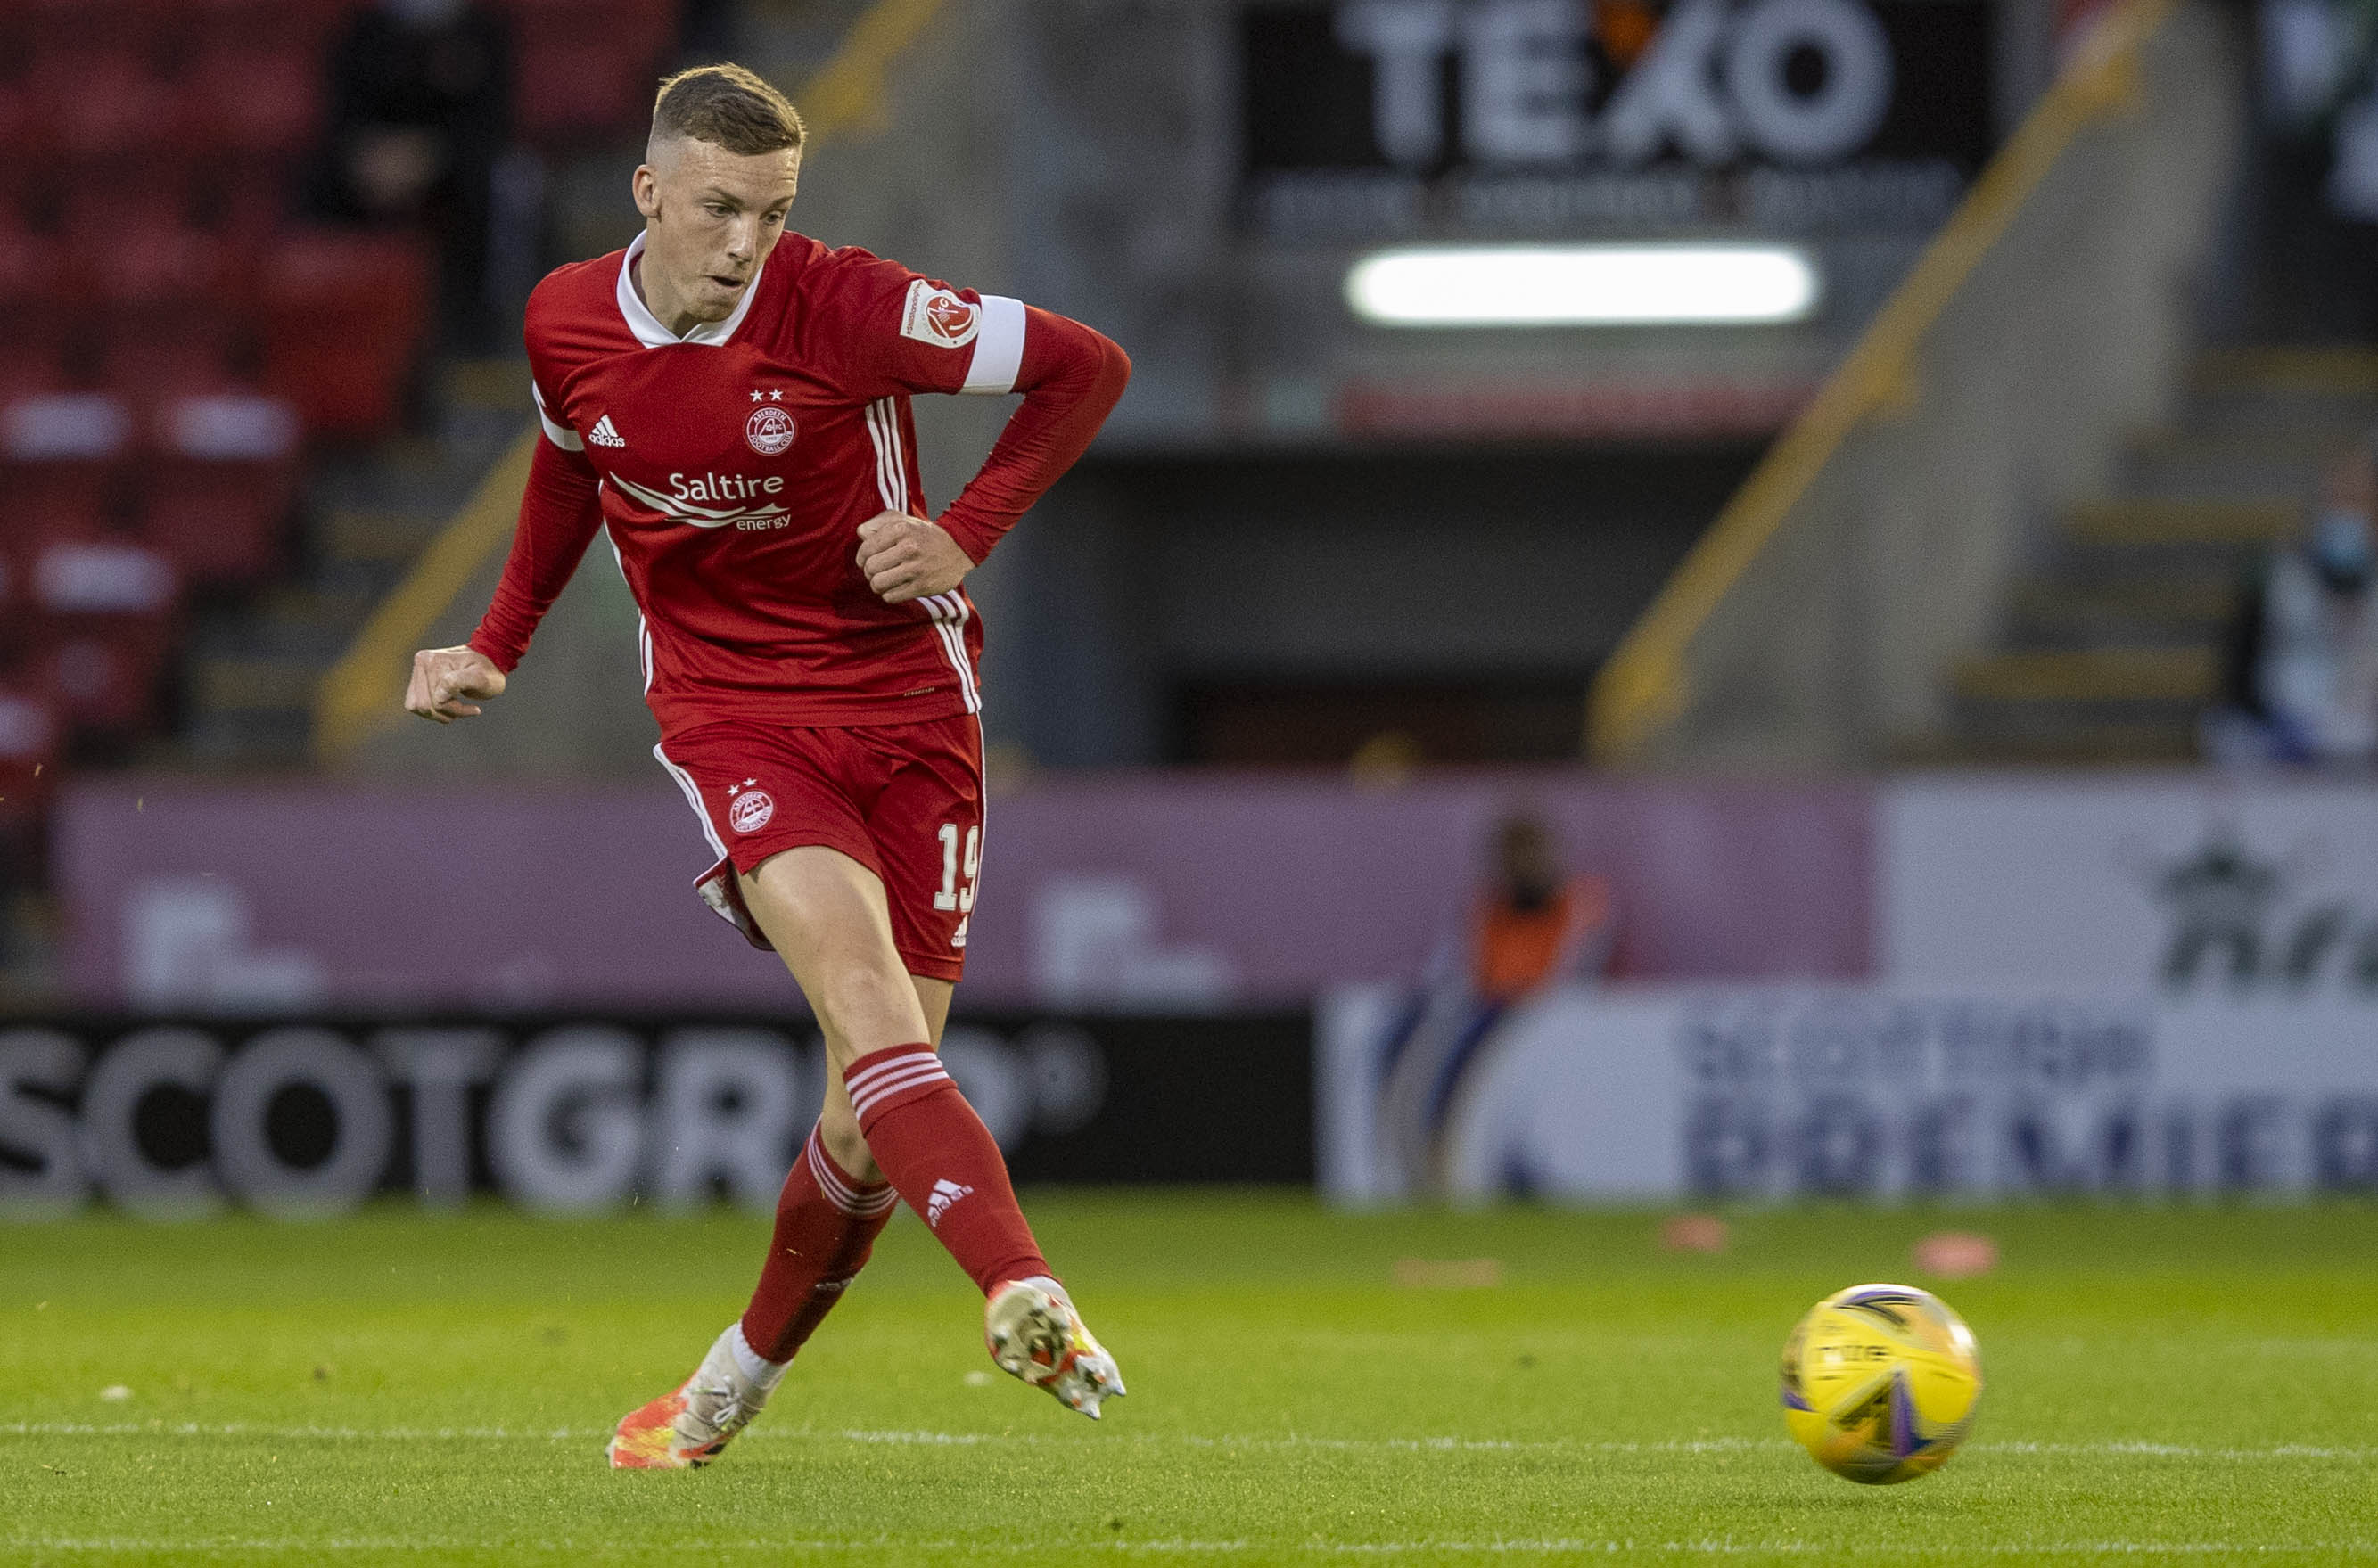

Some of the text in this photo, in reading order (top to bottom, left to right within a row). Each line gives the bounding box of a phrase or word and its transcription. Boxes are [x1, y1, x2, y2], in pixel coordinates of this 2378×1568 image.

[1337, 0, 1897, 166] TEXO
[588, 434, 625, 447] adidas
[669, 472, 785, 501] Saltire
[736, 514, 792, 531] energy
[933, 823, 979, 913] 19
